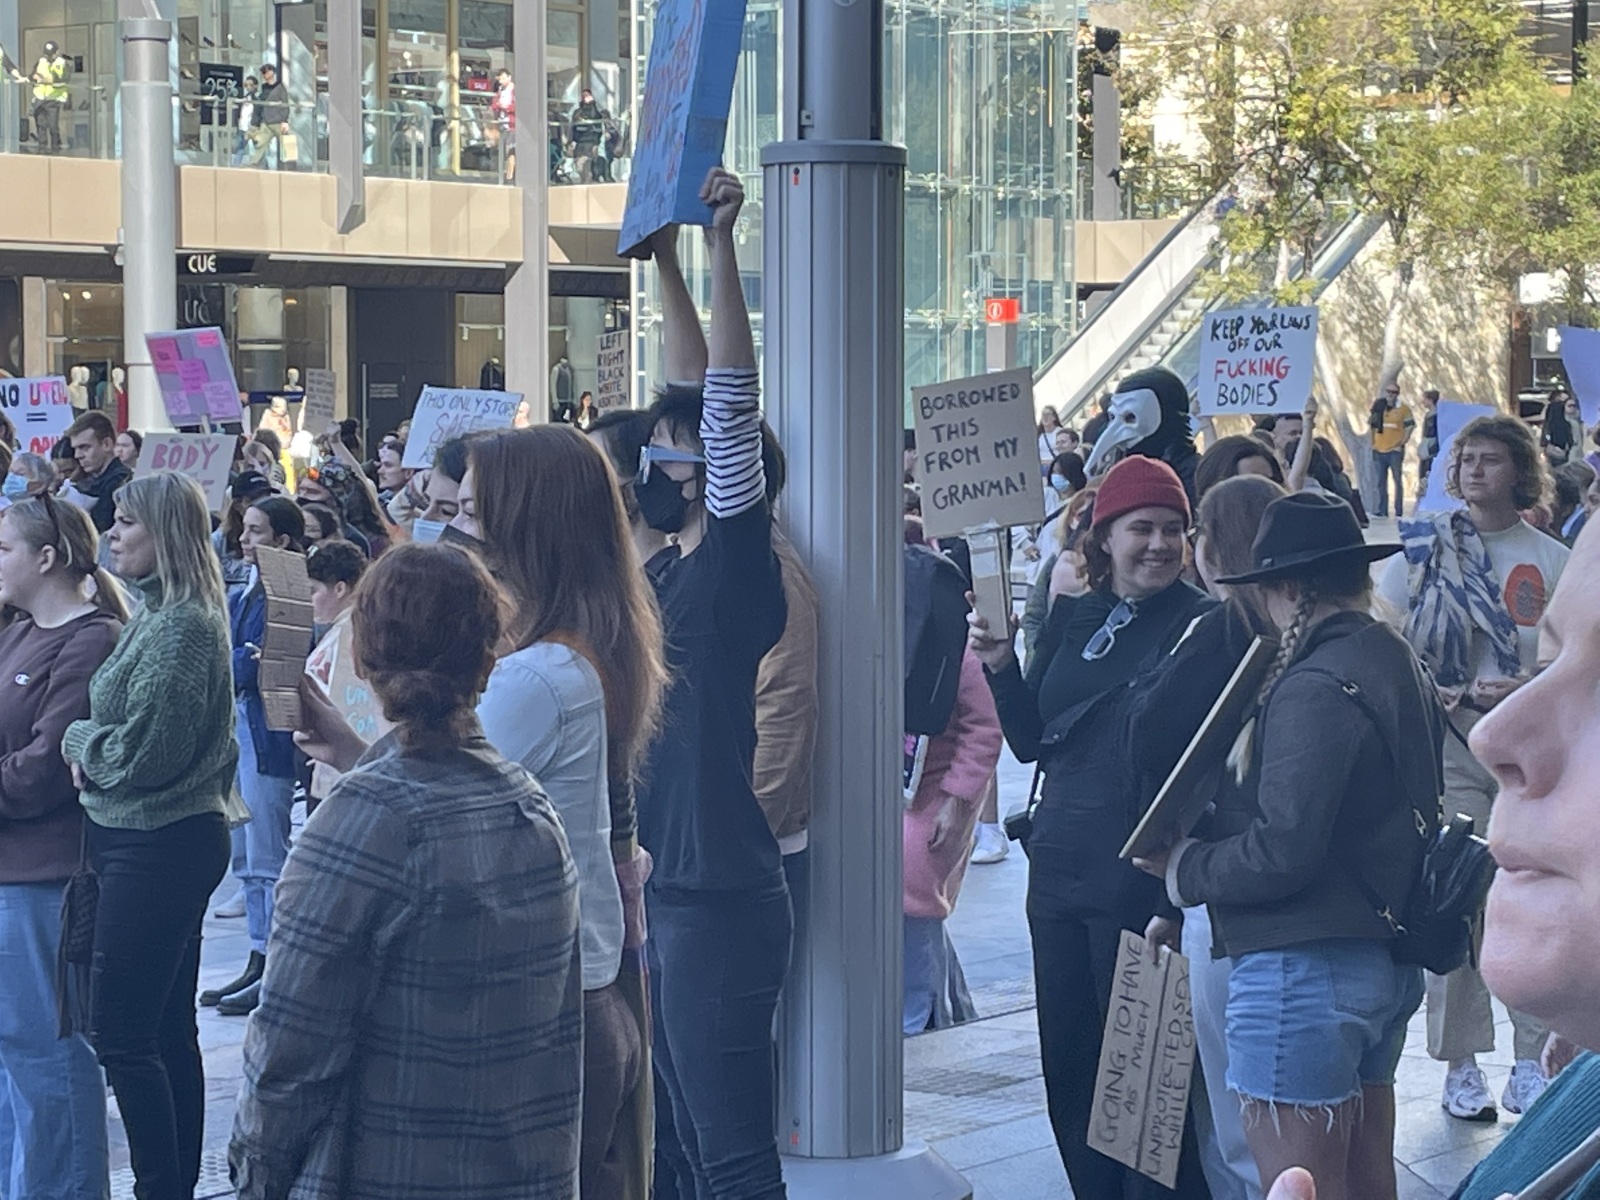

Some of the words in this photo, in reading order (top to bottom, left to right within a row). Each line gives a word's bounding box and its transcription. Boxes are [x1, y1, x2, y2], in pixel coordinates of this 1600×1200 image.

[187, 254, 217, 273] CUE
[600, 332, 623, 351] LEFT
[1211, 315, 1244, 342] KEEP
[1249, 312, 1278, 335] YOUR
[1281, 313, 1312, 330] LAWS
[1228, 337, 1250, 353] OFF
[1254, 332, 1283, 352] OUR
[597, 349, 624, 367] RIGHT
[1215, 355, 1291, 382] FUCKING
[597, 367, 624, 384] BLACK
[421, 391, 447, 410] THIS
[449, 395, 481, 413] ONLY
[920, 383, 1020, 420] BORROWED
[1217, 379, 1280, 407] BODIES
[930, 417, 979, 443] THIS
[151, 439, 220, 470] BODY
[924, 445, 980, 474] FROM
[994, 437, 1018, 459] MY
[1119, 936, 1143, 1003] HAVE
[1113, 1005, 1132, 1036] TO
[1123, 1085, 1138, 1115] AS
[1131, 1000, 1150, 1069] MUCH
[1146, 1018, 1182, 1176] UNPROTECTED
[1172, 964, 1190, 1016] SEX
[1096, 1048, 1128, 1143] GOING
[1164, 1079, 1187, 1150] WHILE
